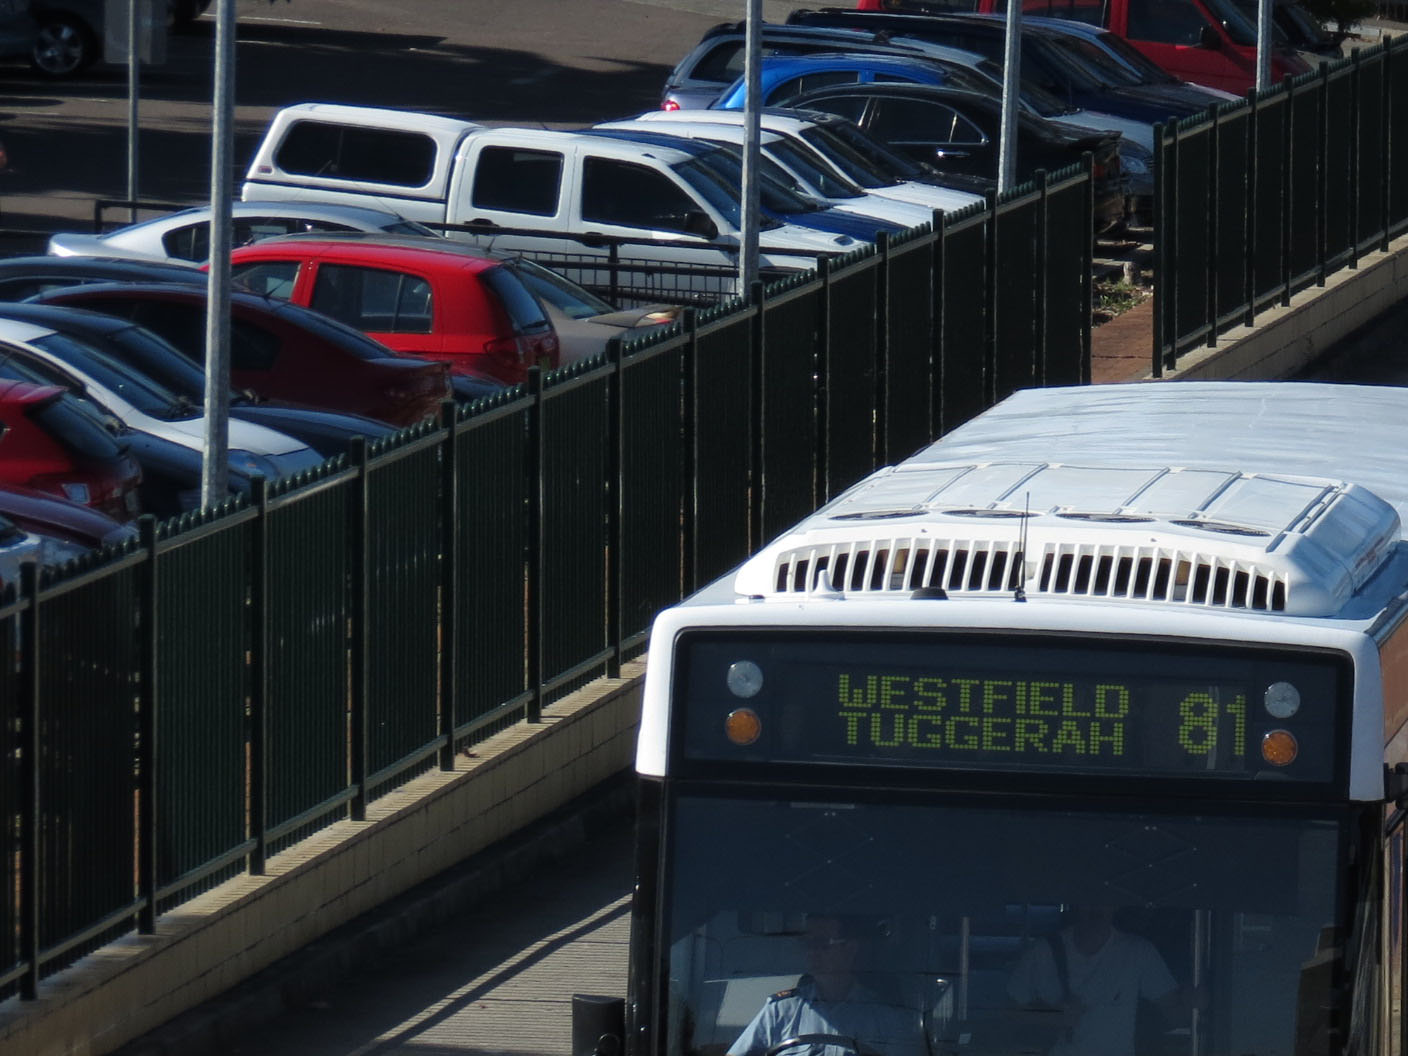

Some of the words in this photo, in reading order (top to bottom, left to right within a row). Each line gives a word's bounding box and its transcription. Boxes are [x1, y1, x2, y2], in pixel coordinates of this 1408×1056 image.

[838, 674, 1130, 719] WESTFIELD
[838, 711, 1125, 757] TUGGERAH
[1177, 692, 1247, 756] 81
